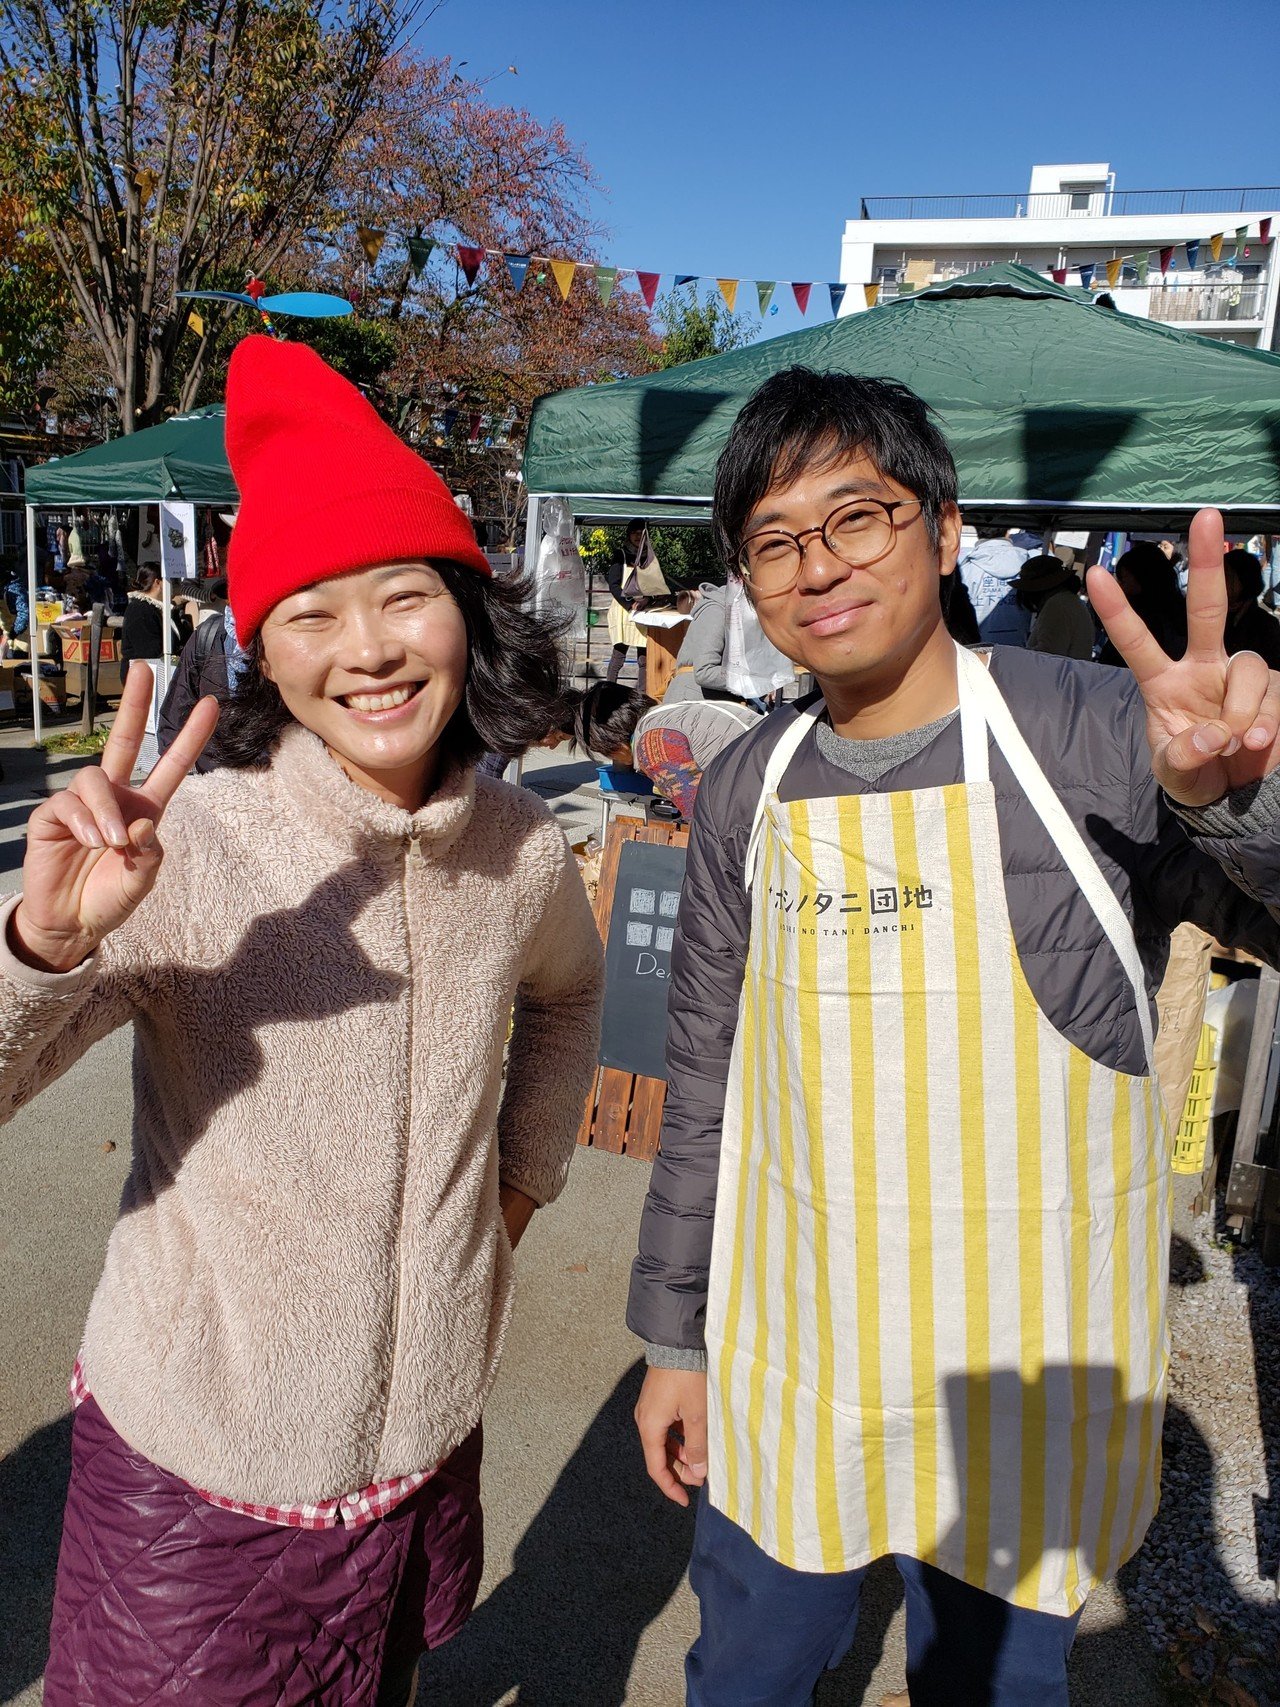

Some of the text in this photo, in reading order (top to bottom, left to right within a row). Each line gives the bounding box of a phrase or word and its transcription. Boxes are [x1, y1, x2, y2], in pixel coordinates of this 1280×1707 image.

[802, 928, 816, 936] NO
[823, 929, 855, 937] TANI
[864, 924, 915, 935] DANCHI
[636, 953, 671, 978] De
